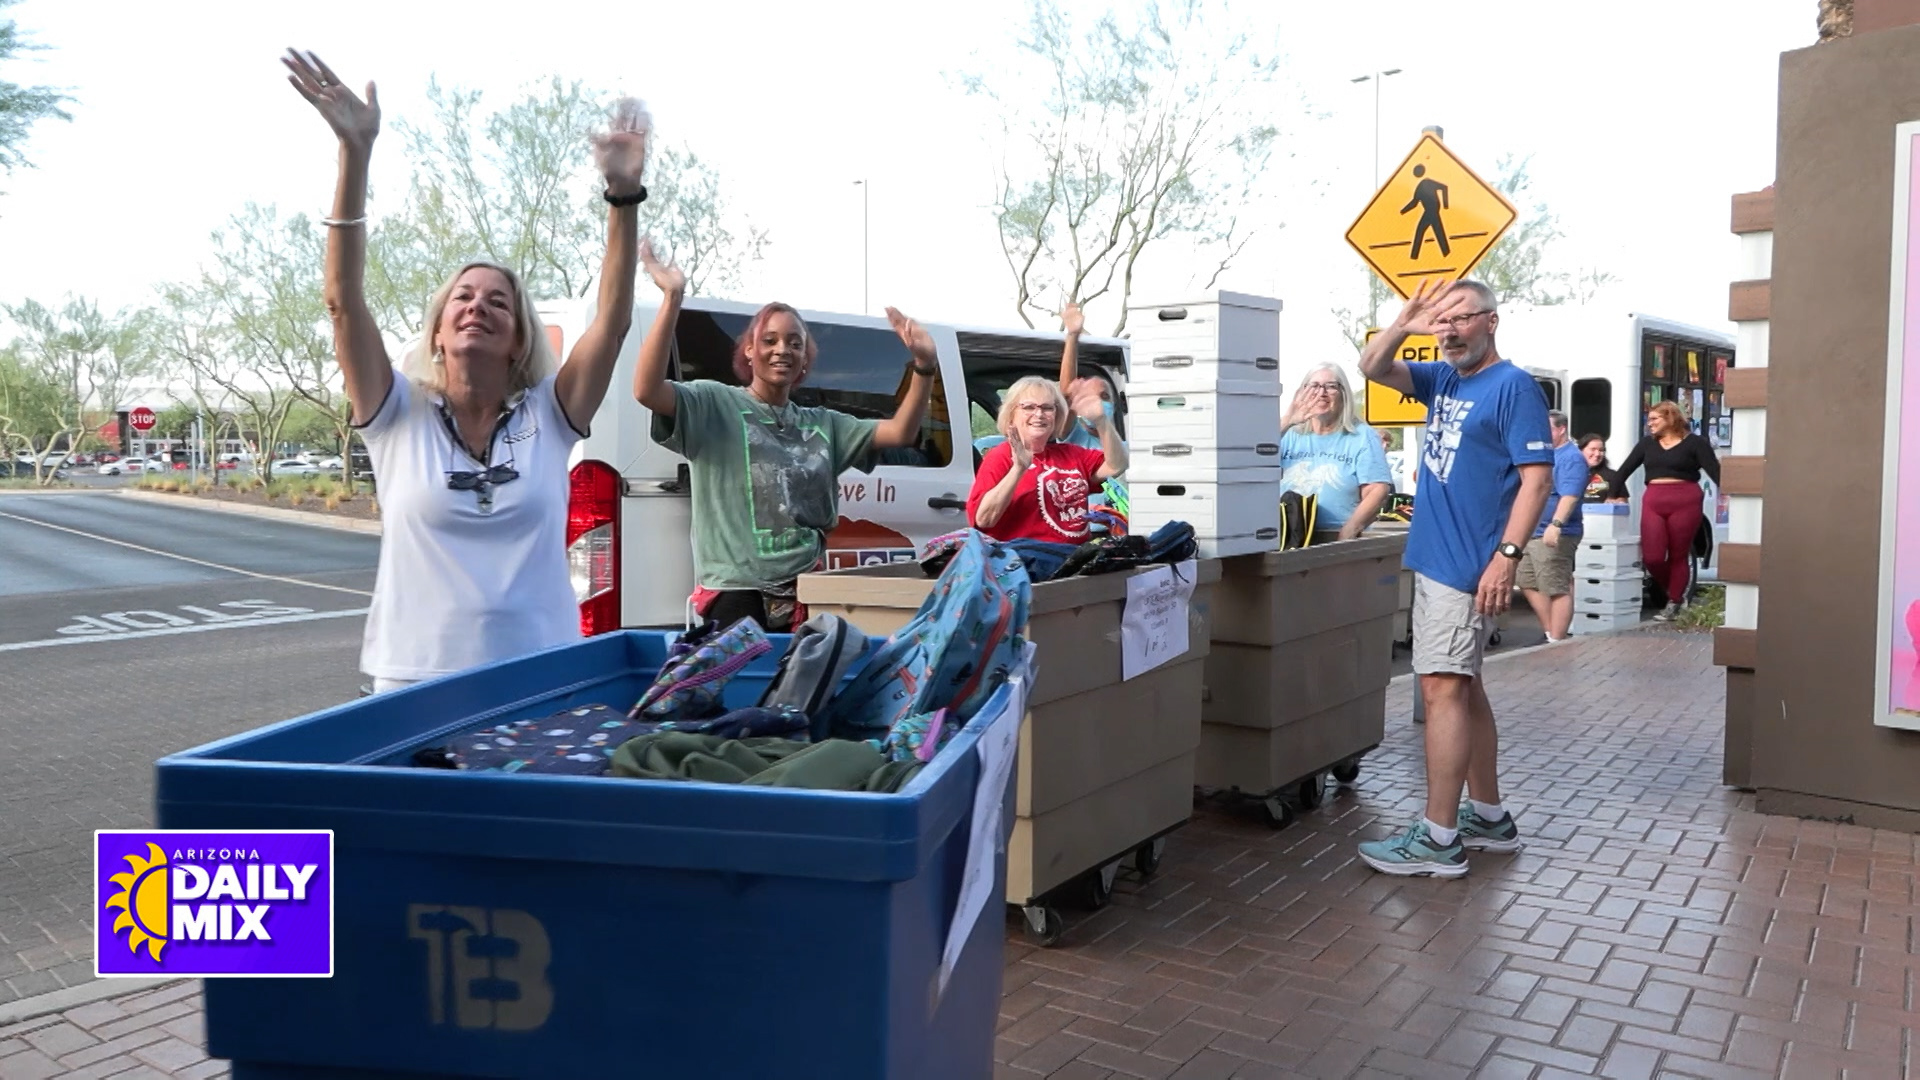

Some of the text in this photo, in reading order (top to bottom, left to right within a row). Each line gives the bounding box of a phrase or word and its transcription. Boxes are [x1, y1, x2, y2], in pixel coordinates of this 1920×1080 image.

[130, 414, 156, 425] STOP
[876, 477, 896, 503] In
[56, 598, 315, 635] STOP
